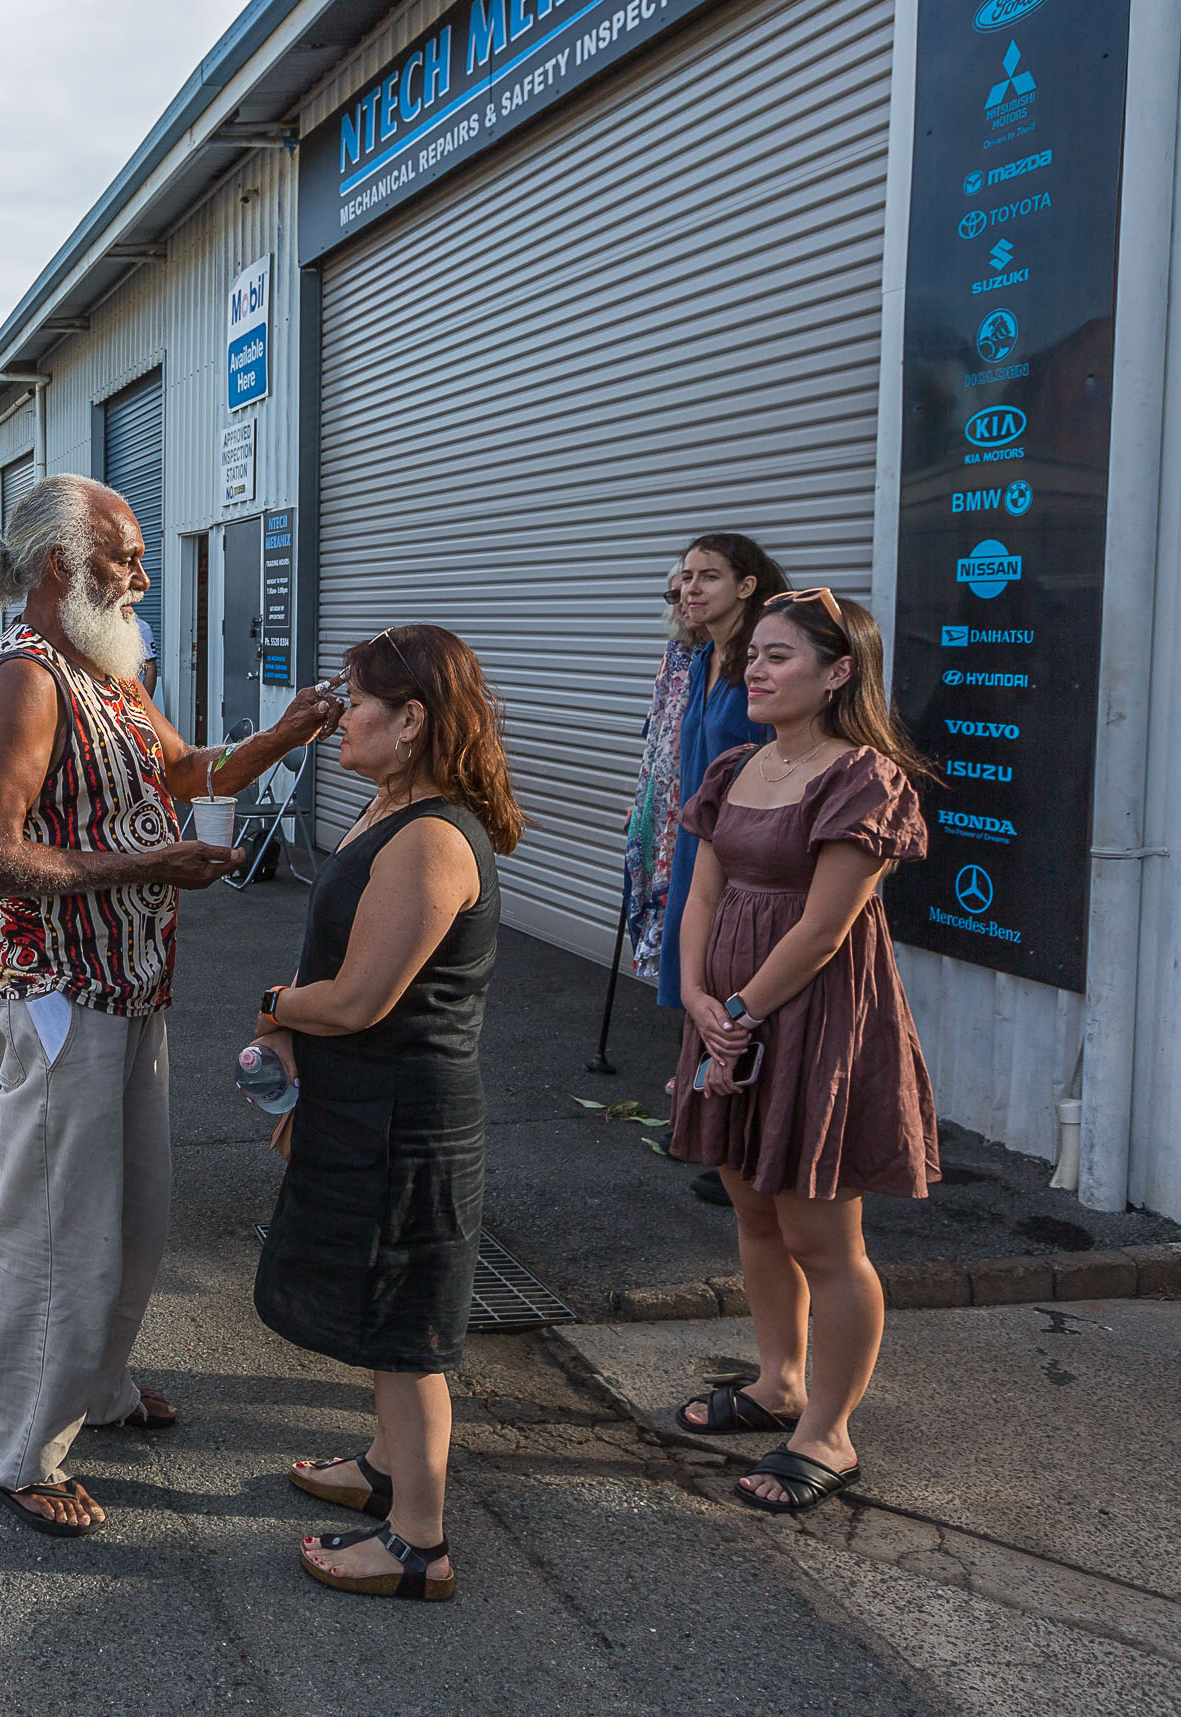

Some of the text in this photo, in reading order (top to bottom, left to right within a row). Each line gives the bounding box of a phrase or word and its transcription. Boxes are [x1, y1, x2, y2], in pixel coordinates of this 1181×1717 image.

[340, 25, 451, 173] NTECH
[987, 91, 1036, 121] MITSUBISHI
[340, 0, 668, 227] MECHANICAL REPAIRS & SAFETY INSPEC
[992, 107, 1028, 130] MOTORS
[989, 192, 1052, 225] TOYOTA
[971, 268, 1029, 294] SUZUKI
[231, 273, 265, 325] Mobil
[230, 338, 264, 374] Available
[237, 370, 256, 393] Here
[964, 362, 1029, 387] HOLDEN
[223, 424, 251, 448] APPROVED
[975, 413, 1017, 439] KIA
[221, 441, 253, 466] INSPECTION
[964, 448, 1024, 464] KIA MOTORS
[226, 463, 248, 483] STATION
[952, 488, 1001, 512] BMW
[268, 514, 288, 530] NTECH
[960, 560, 1018, 577] NISSAN
[970, 629, 1034, 644] DAIHATSU
[966, 672, 1028, 687] HYUNDAI
[944, 719, 1019, 739] VOLVO
[947, 760, 1013, 782] ISUZU
[938, 810, 1018, 835] HONDA
[928, 906, 1021, 943] Mercedes-Benz
